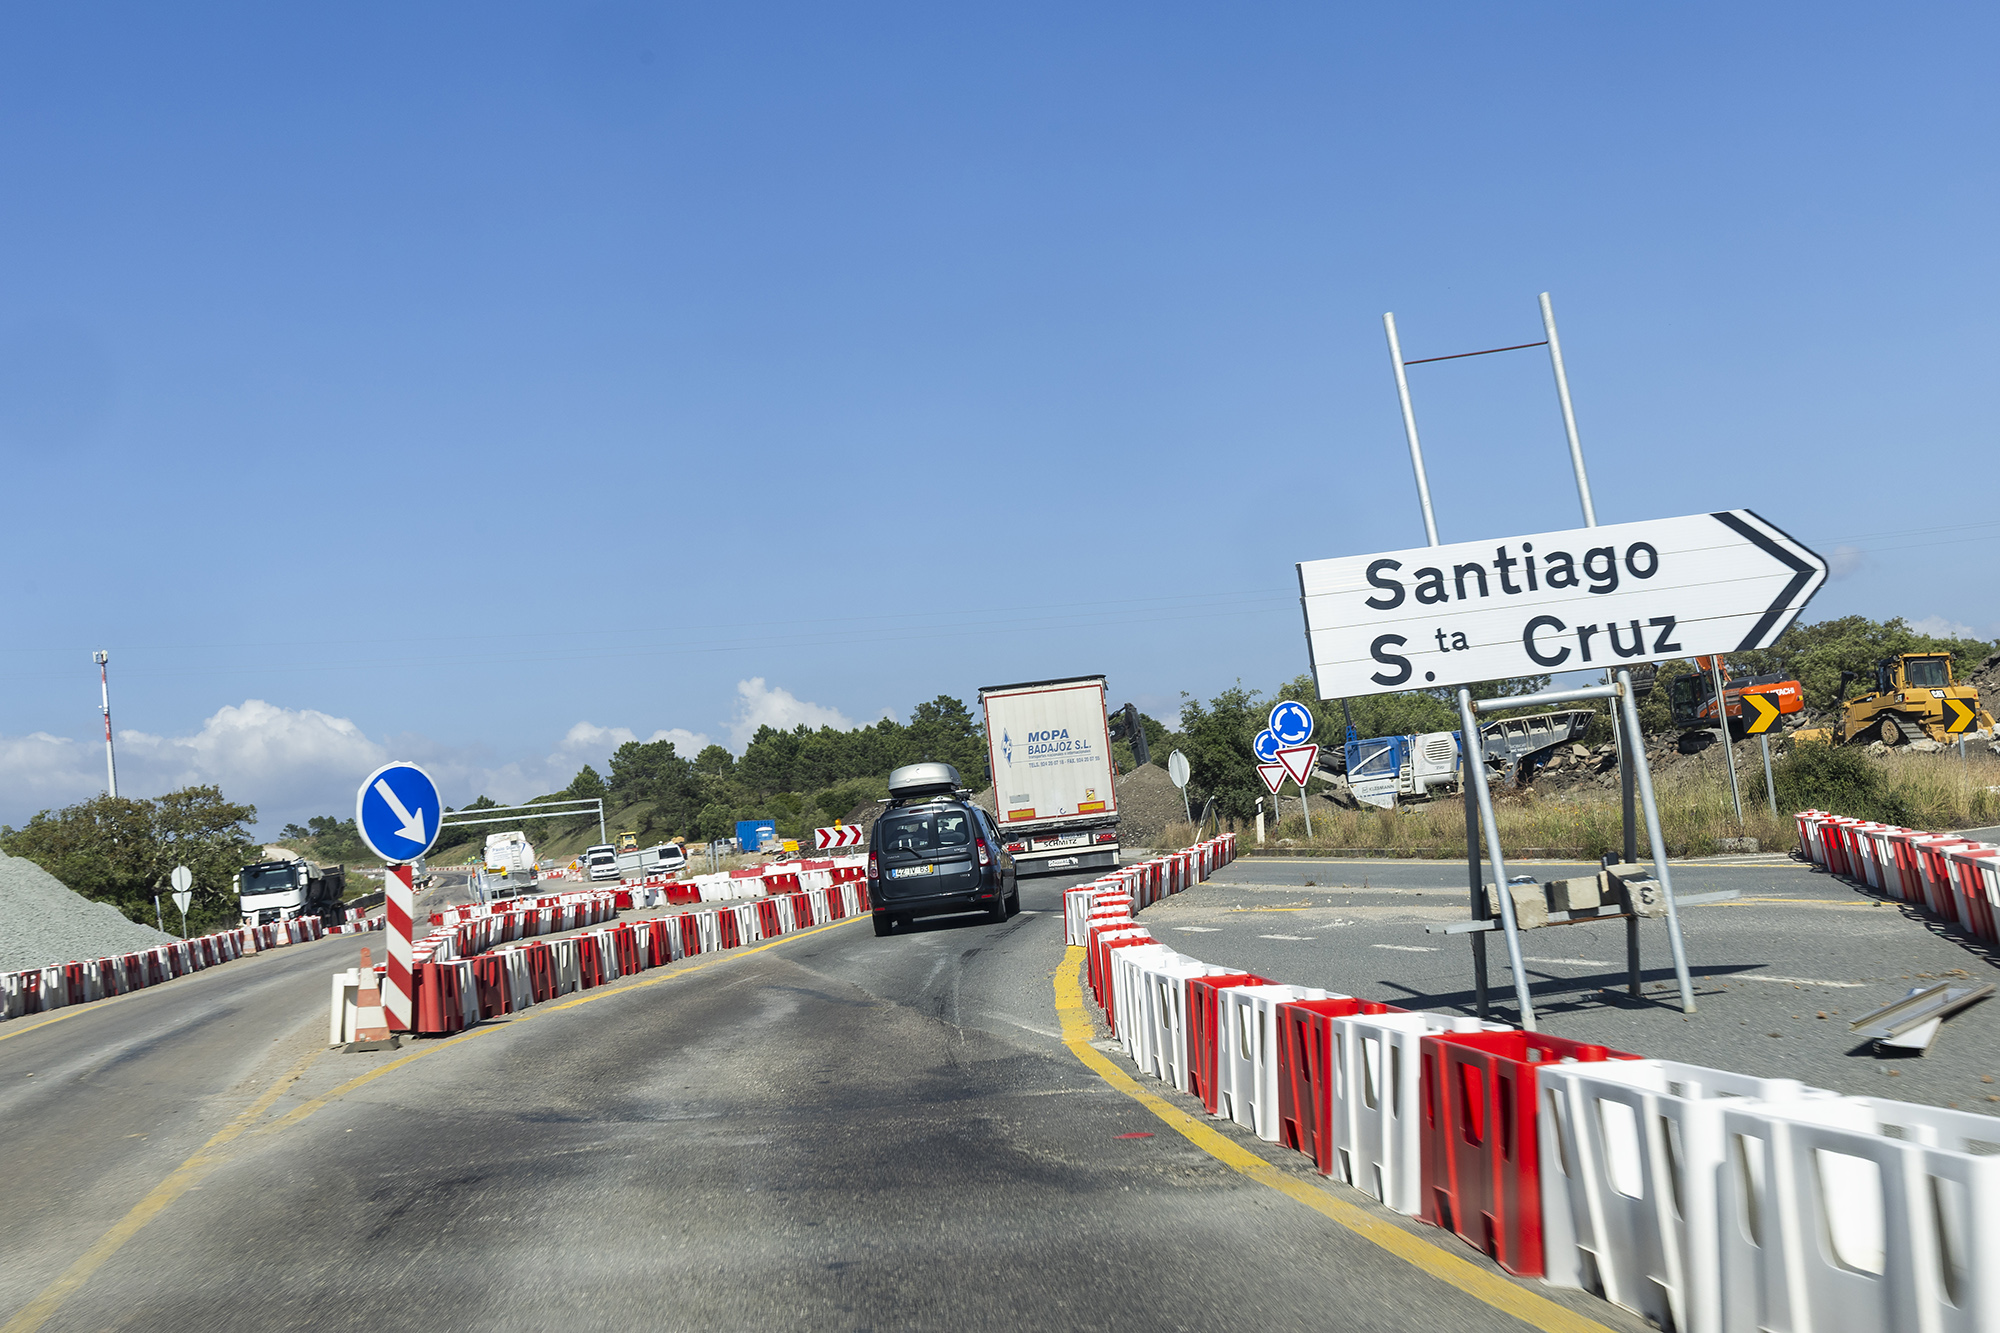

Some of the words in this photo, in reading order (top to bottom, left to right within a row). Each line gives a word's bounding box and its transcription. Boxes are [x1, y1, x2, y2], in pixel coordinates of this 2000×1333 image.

[1364, 541, 1659, 611] Santiago
[1521, 614, 1682, 668] Cruz
[1028, 728, 1069, 742] MOPA
[1028, 741, 1072, 754] BADAJOZ
[1074, 739, 1092, 750] S.L.
[1044, 839, 1077, 848] SCHMITZ
